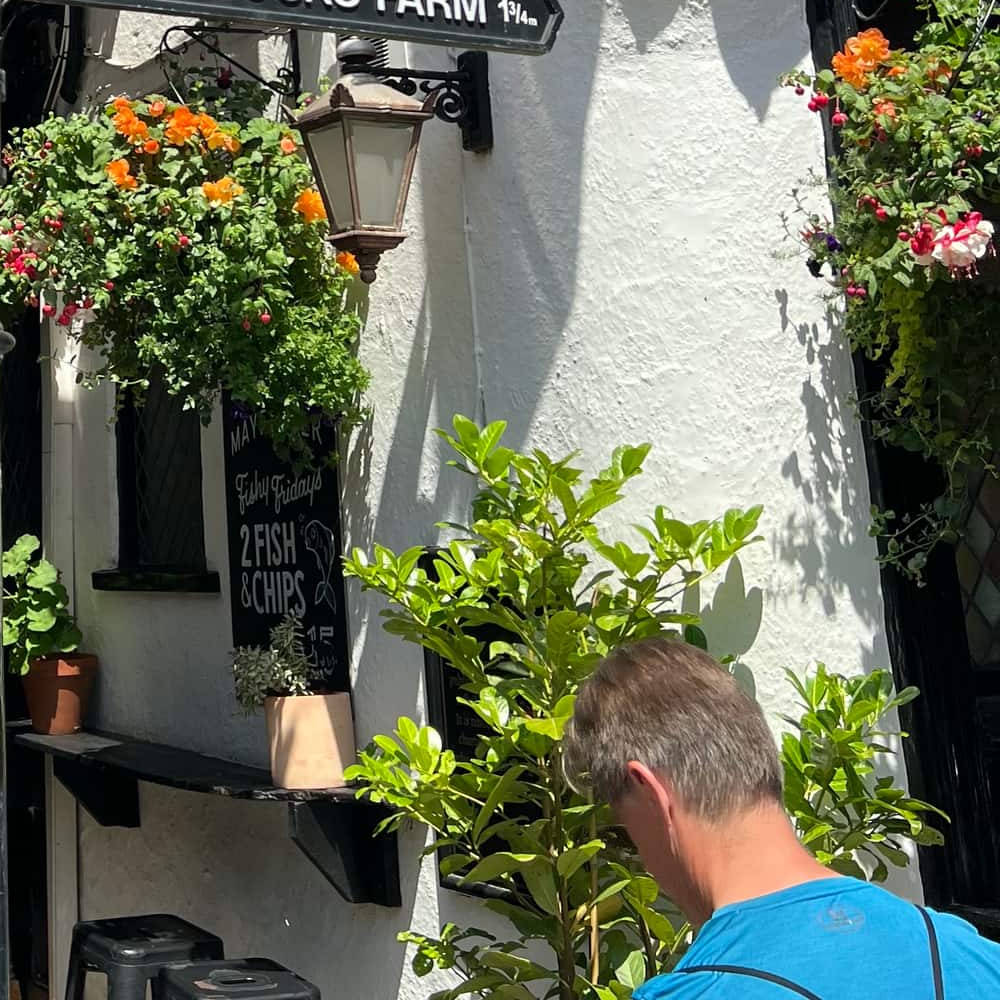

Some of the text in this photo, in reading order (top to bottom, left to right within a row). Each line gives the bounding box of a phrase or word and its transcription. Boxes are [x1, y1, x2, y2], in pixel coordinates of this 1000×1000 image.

[235, 467, 322, 515] Fishy Fridays
[240, 521, 297, 568] 2 FISH
